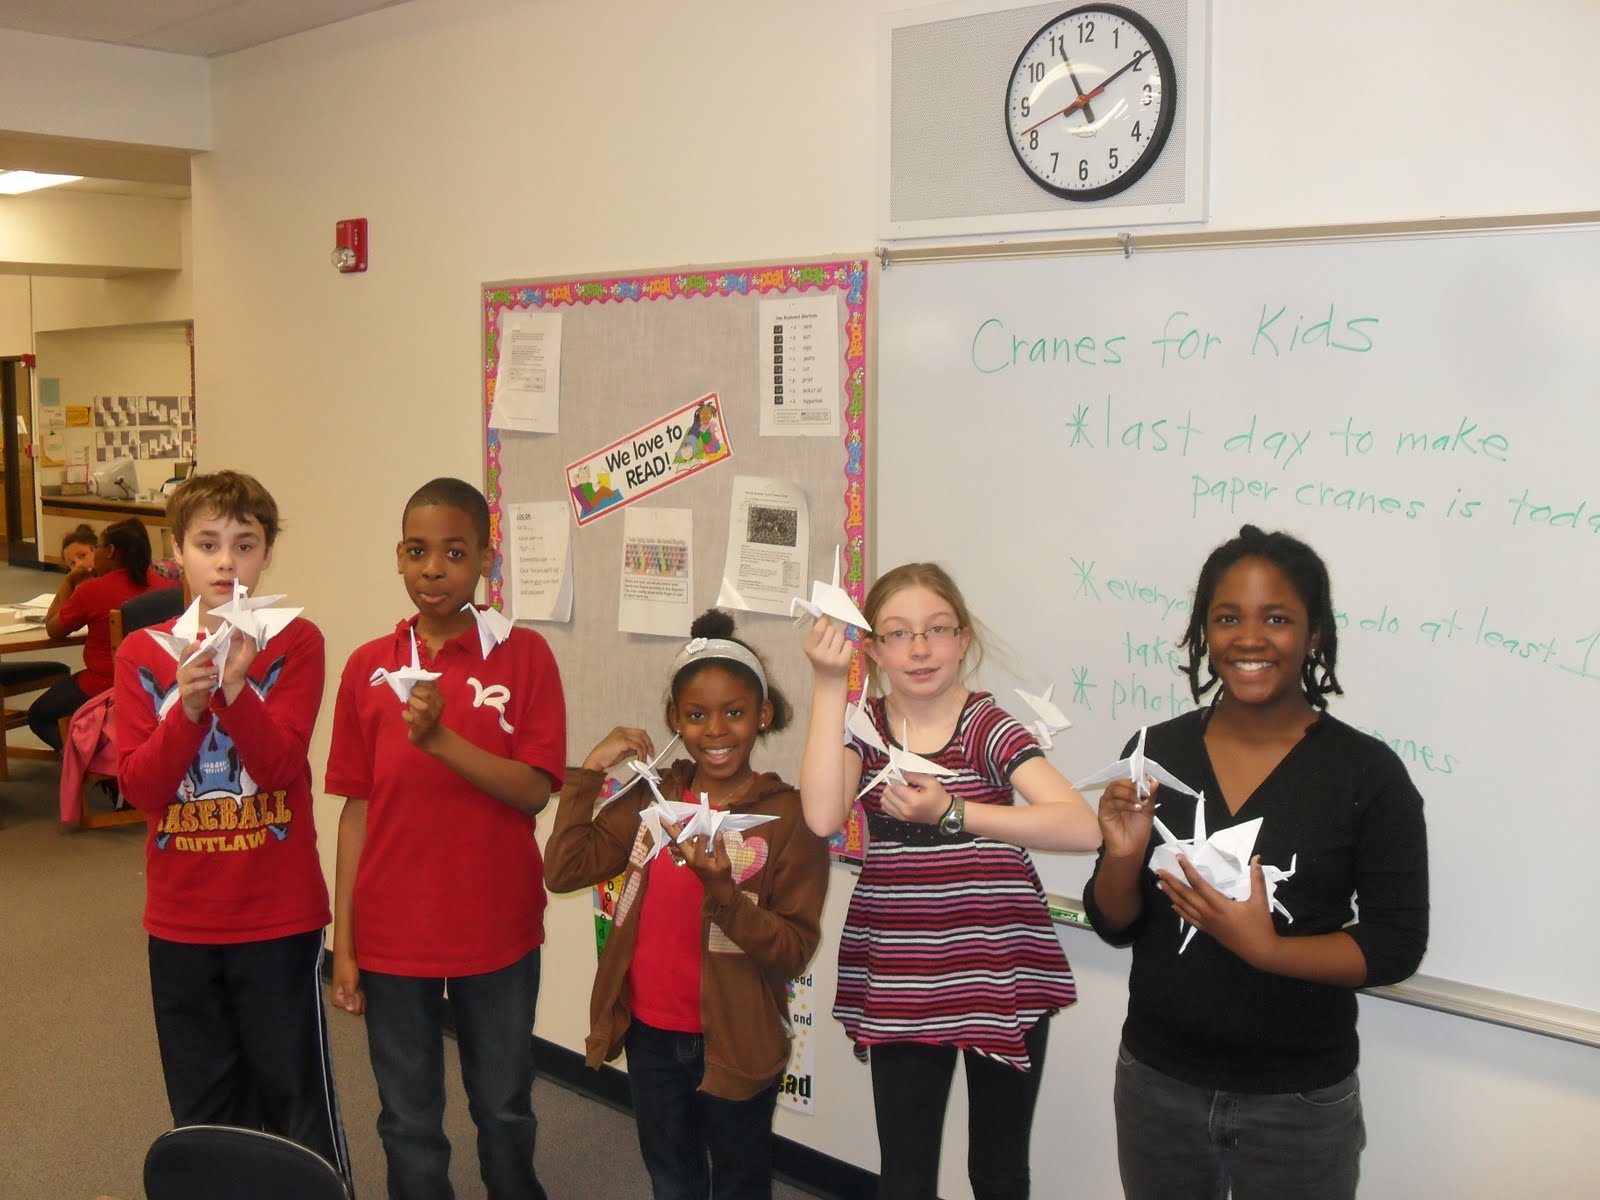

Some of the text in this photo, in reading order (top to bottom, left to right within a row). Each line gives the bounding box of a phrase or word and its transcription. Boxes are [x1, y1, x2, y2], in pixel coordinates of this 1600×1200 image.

[1078, 21, 1095, 44] 12
[1112, 27, 1120, 49] 1
[1050, 35, 1065, 57] 11
[1029, 61, 1045, 84] 10
[1133, 50, 1143, 72] 2
[1141, 84, 1153, 106] 3
[1021, 96, 1031, 118] 9
[1029, 130, 1039, 151] 8
[1131, 120, 1142, 142] 4
[1050, 152, 1060, 174] 7
[1079, 159, 1088, 181] 6
[1109, 148, 1119, 170] 5
[972, 302, 1380, 374] Cranes for Kids
[1106, 394, 1510, 471] last day to make
[605, 425, 683, 473] We love to
[625, 451, 672, 489] READ!
[1191, 473, 1279, 519] paper
[1296, 481, 1427, 521] cranes
[1446, 488, 1481, 520] is
[846, 491, 862, 527] Read
[1105, 578, 1193, 621] everyo
[1359, 605, 1399, 633] do
[1420, 609, 1464, 642] at
[1475, 605, 1557, 663] least
[1121, 631, 1182, 677] take
[157, 789, 292, 834] ASEBALL
[175, 828, 267, 852] OUTLAW
[793, 1013, 812, 1026] and
